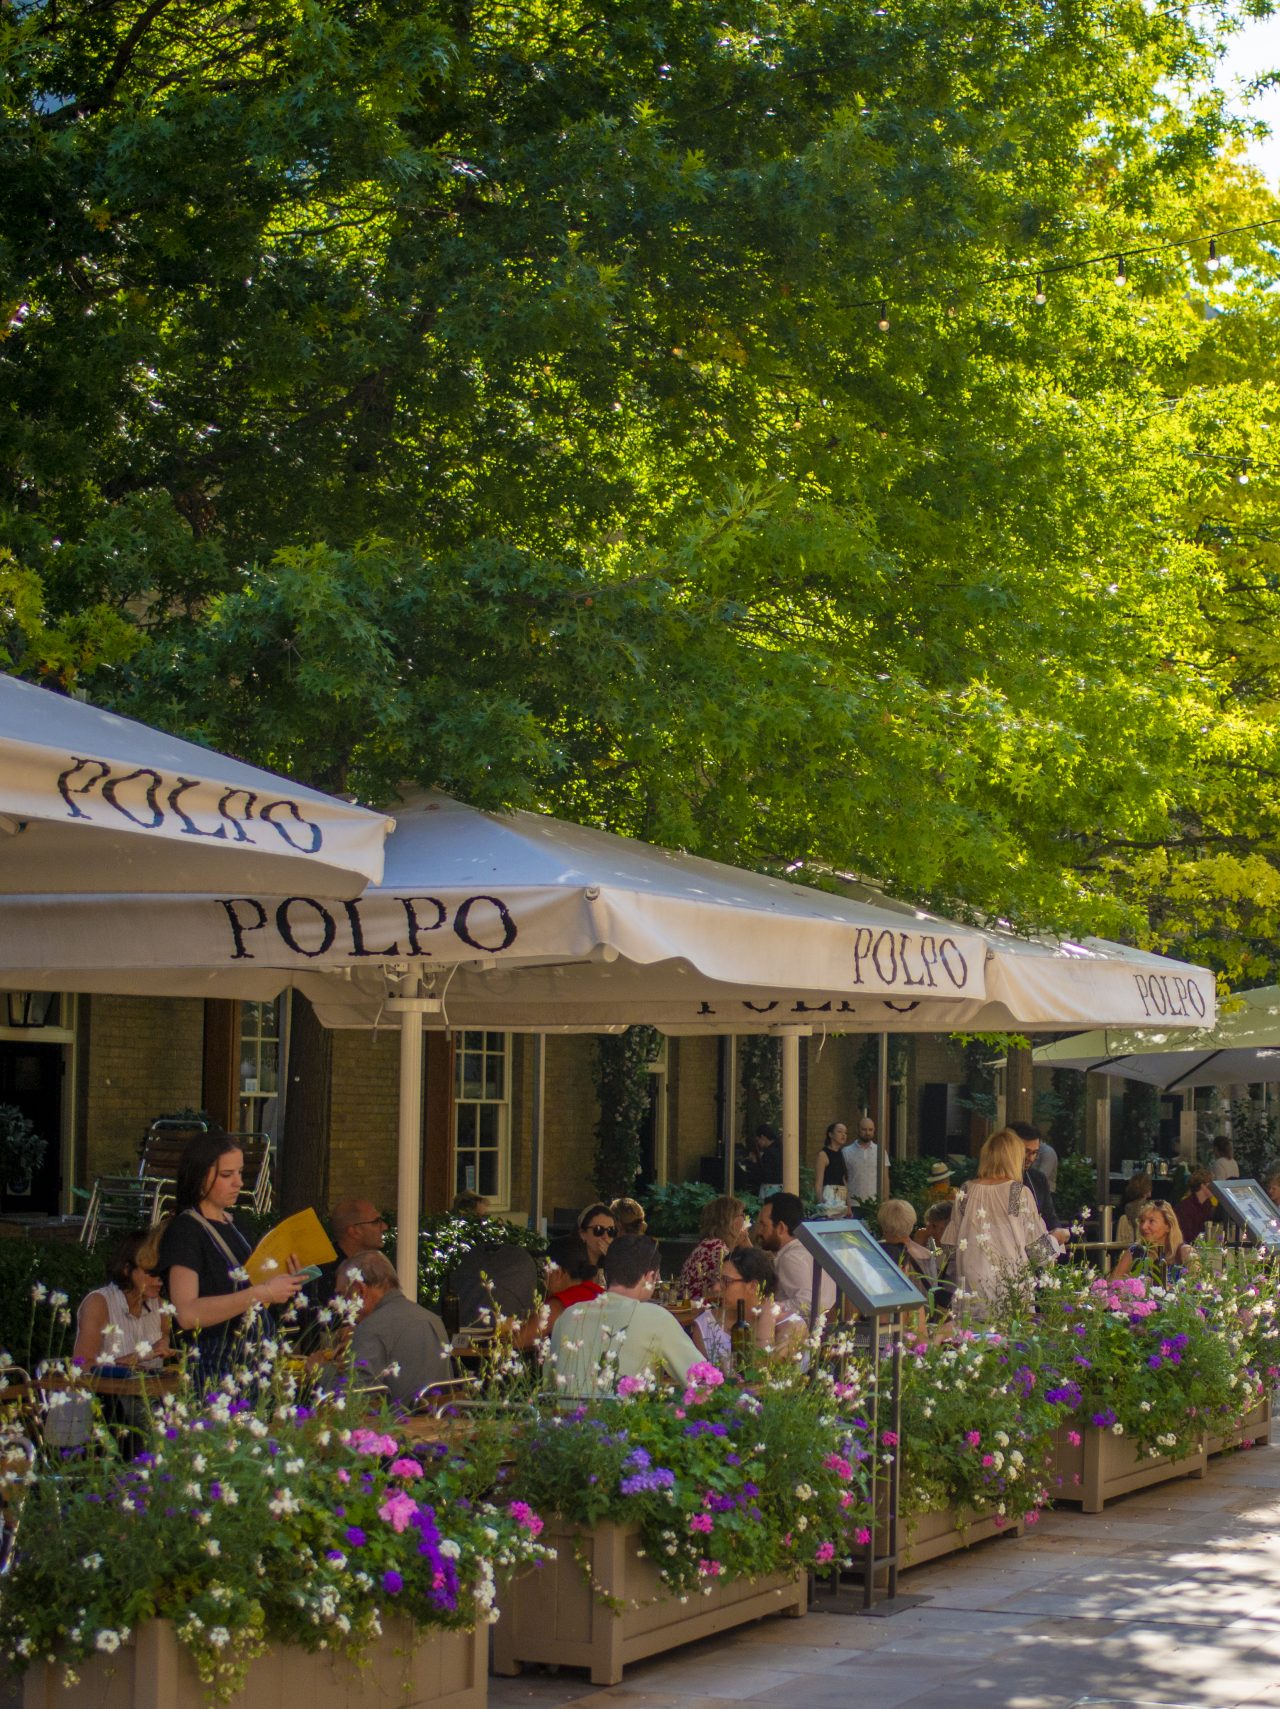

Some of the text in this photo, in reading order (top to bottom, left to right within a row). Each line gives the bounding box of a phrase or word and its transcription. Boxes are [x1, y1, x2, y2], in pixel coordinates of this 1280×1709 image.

[57, 756, 323, 854] POLPO
[213, 896, 518, 958] POLPO
[853, 926, 968, 990] POLPO
[1132, 974, 1206, 1018] POLPO
